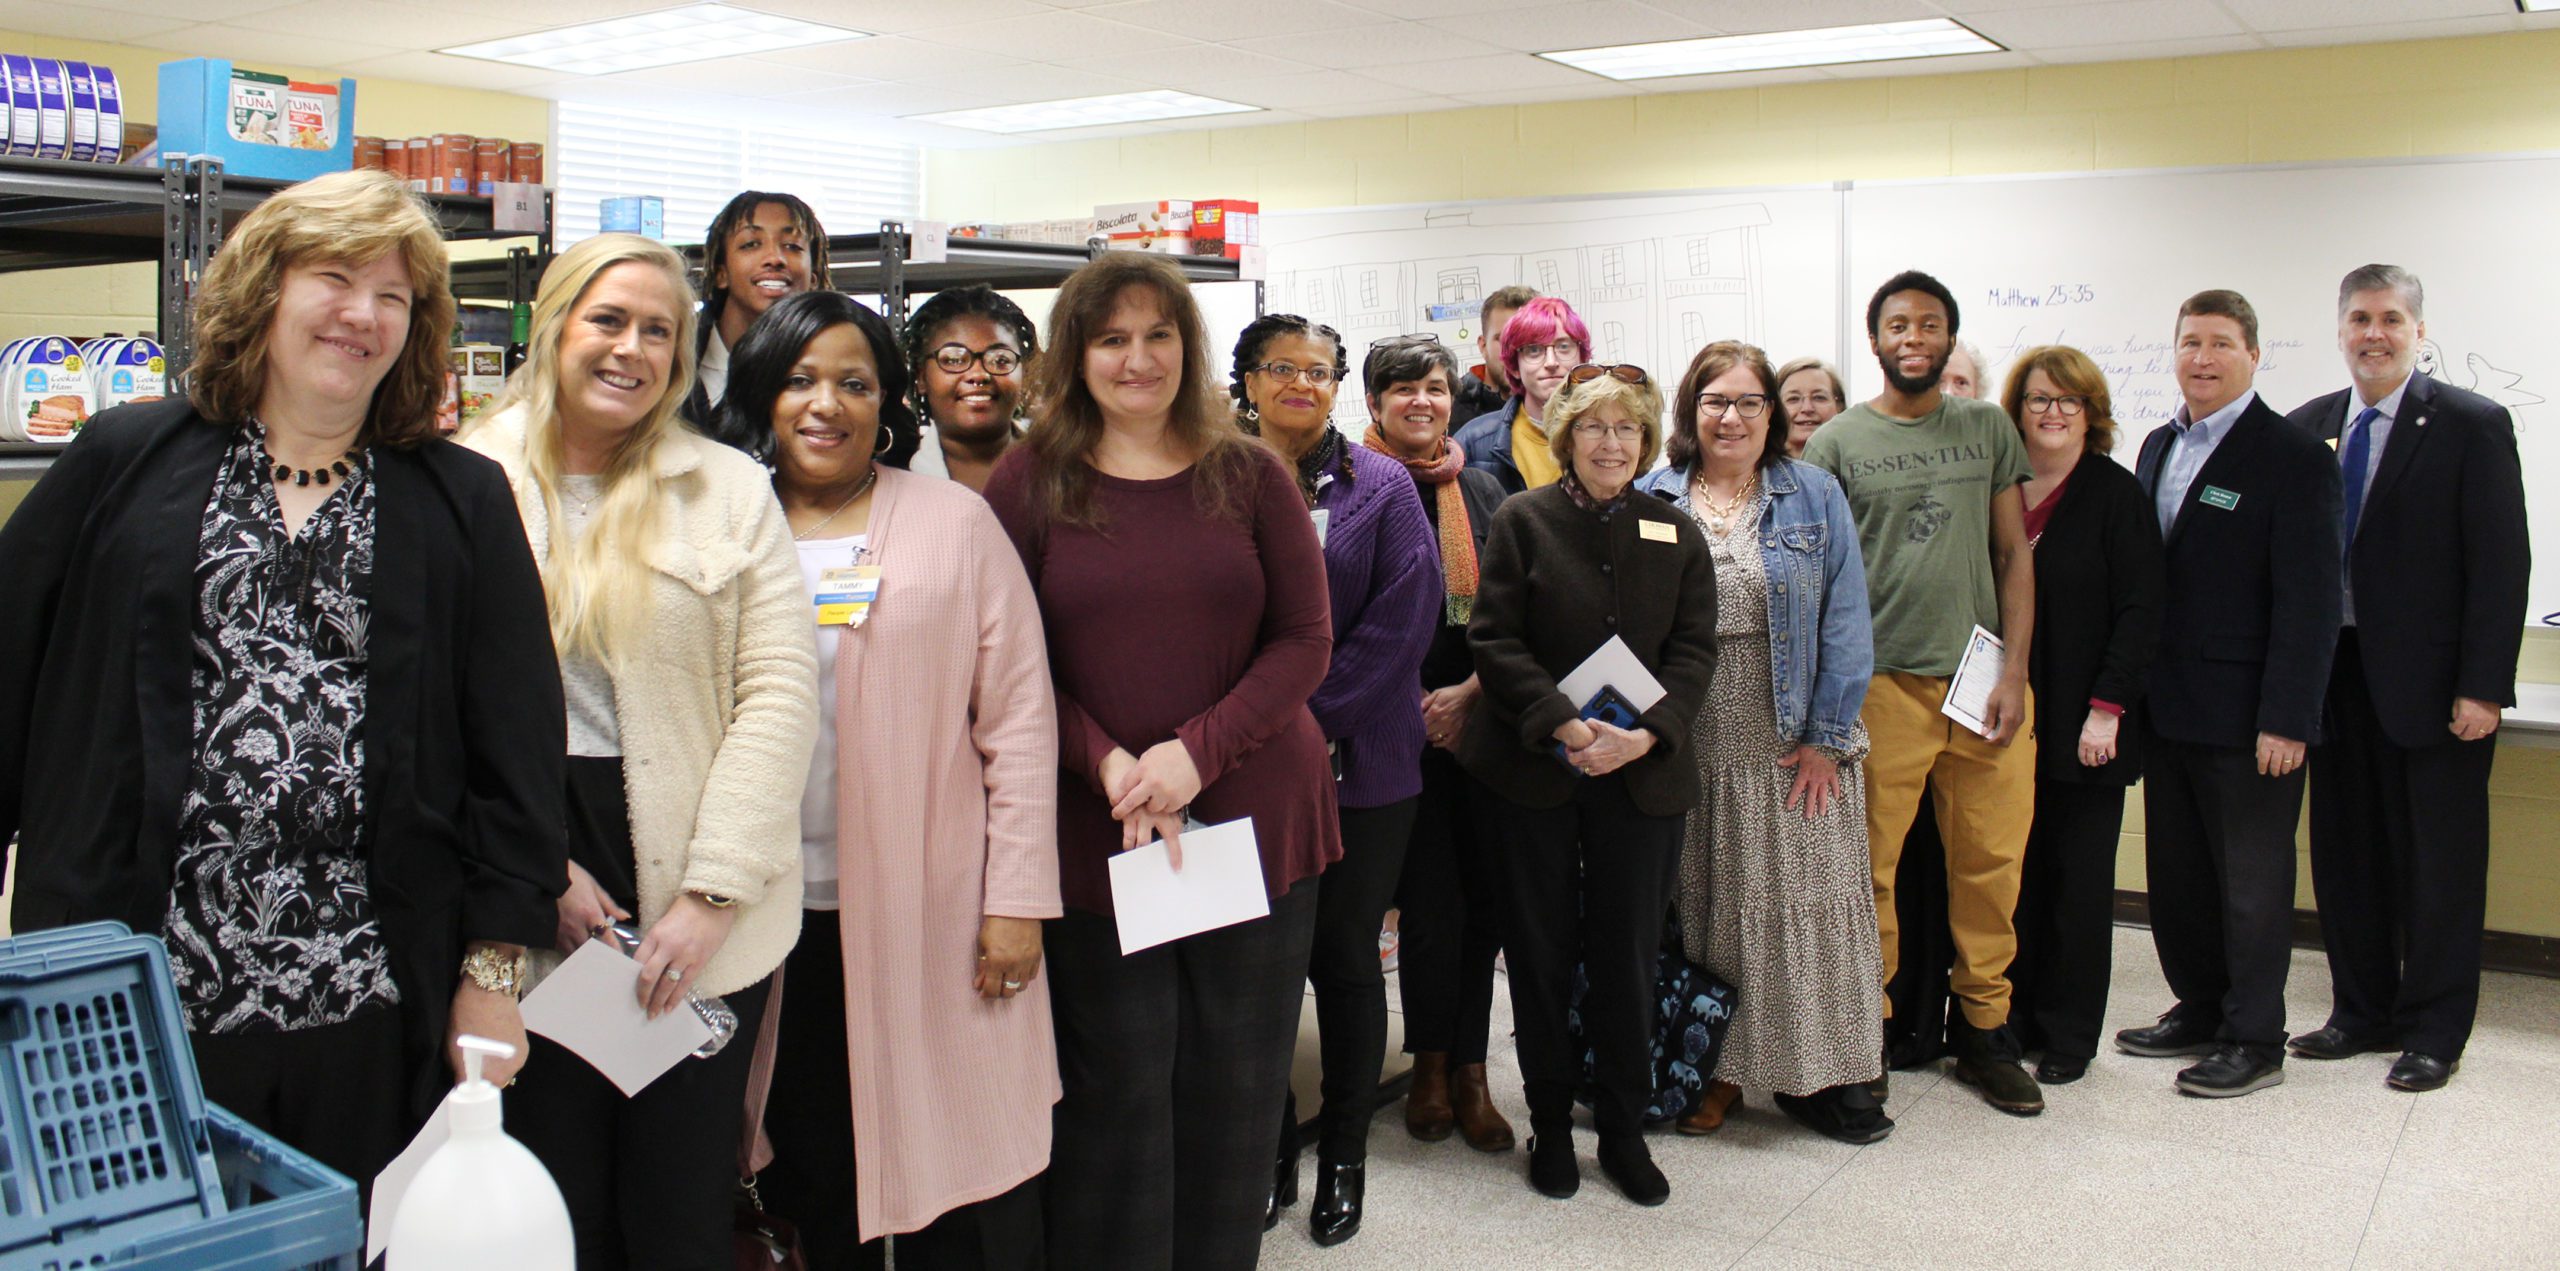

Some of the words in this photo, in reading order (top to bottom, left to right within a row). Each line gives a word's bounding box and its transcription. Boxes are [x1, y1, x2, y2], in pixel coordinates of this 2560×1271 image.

[236, 95, 274, 110] TUNA
[516, 202, 528, 211] B1
[1096, 212, 1138, 232] Biscolata
[1988, 287, 2040, 307] Matthew
[2044, 284, 2095, 306] 25:35
[50, 373, 82, 383] Cooked
[50, 382, 73, 391] Ham
[136, 383, 156, 391] Ham
[2132, 405, 2175, 420] drin
[833, 582, 864, 590] TAMMY
